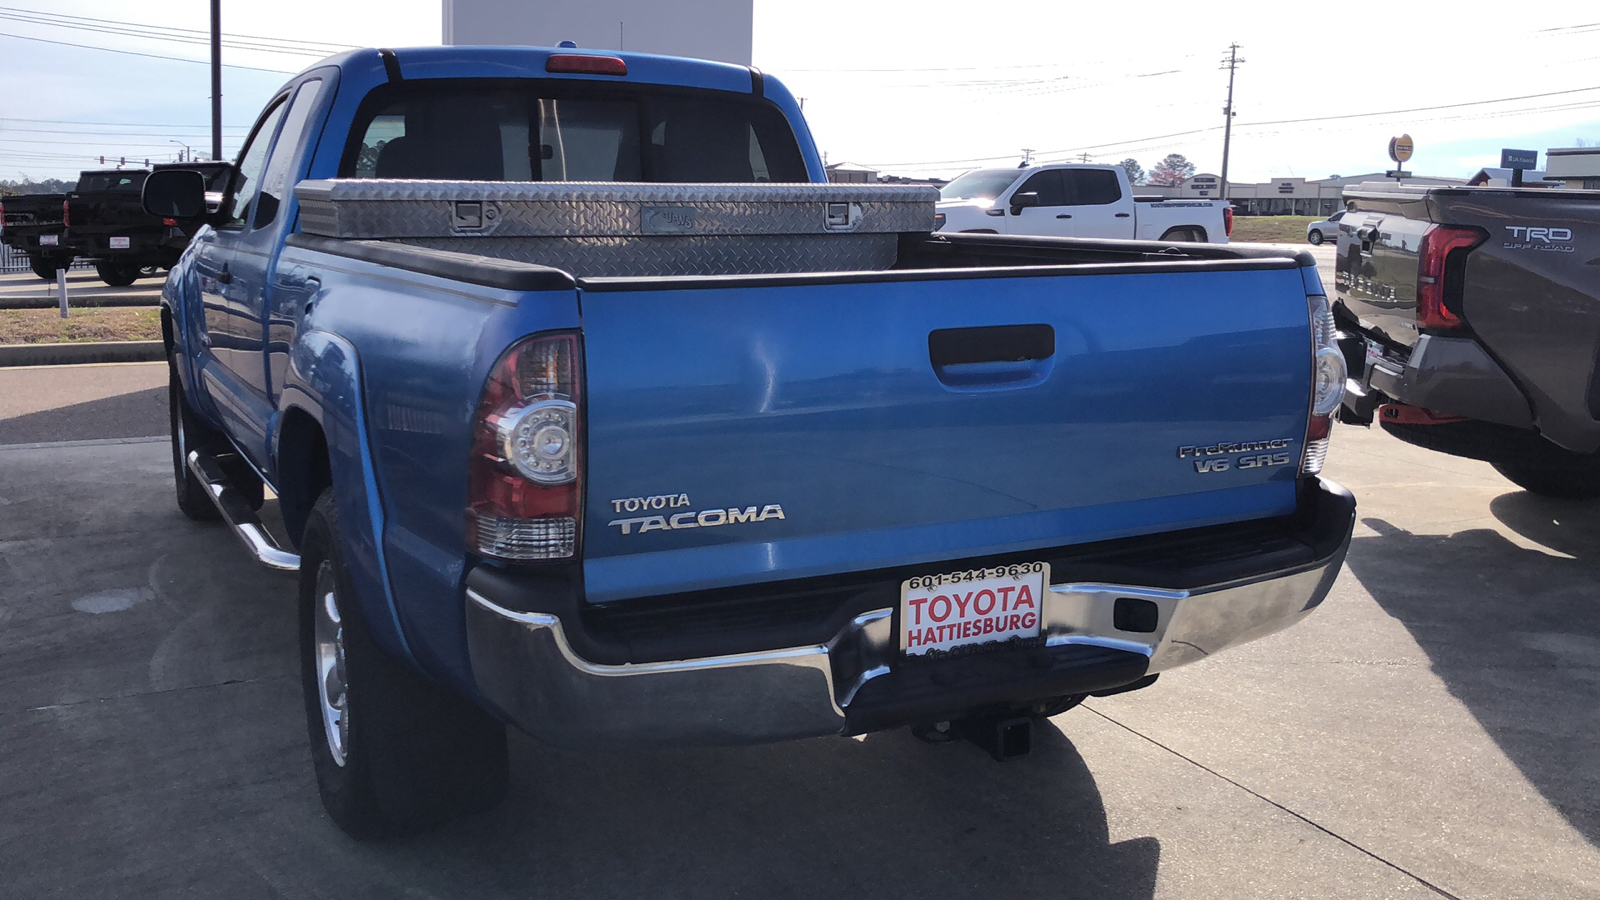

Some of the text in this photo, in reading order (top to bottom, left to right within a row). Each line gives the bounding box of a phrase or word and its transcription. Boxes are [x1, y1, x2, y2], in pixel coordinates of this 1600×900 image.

[1505, 225, 1572, 244] TRD
[1178, 437, 1293, 458] PreRunner
[1194, 452, 1290, 473] V6 SR5
[611, 493, 690, 513] TOYOTA
[607, 504, 786, 535] TACOMA
[909, 562, 1043, 589] 601-544-9630
[908, 584, 1035, 625] TOYOTA
[907, 611, 1037, 648] HATTIESBURG
